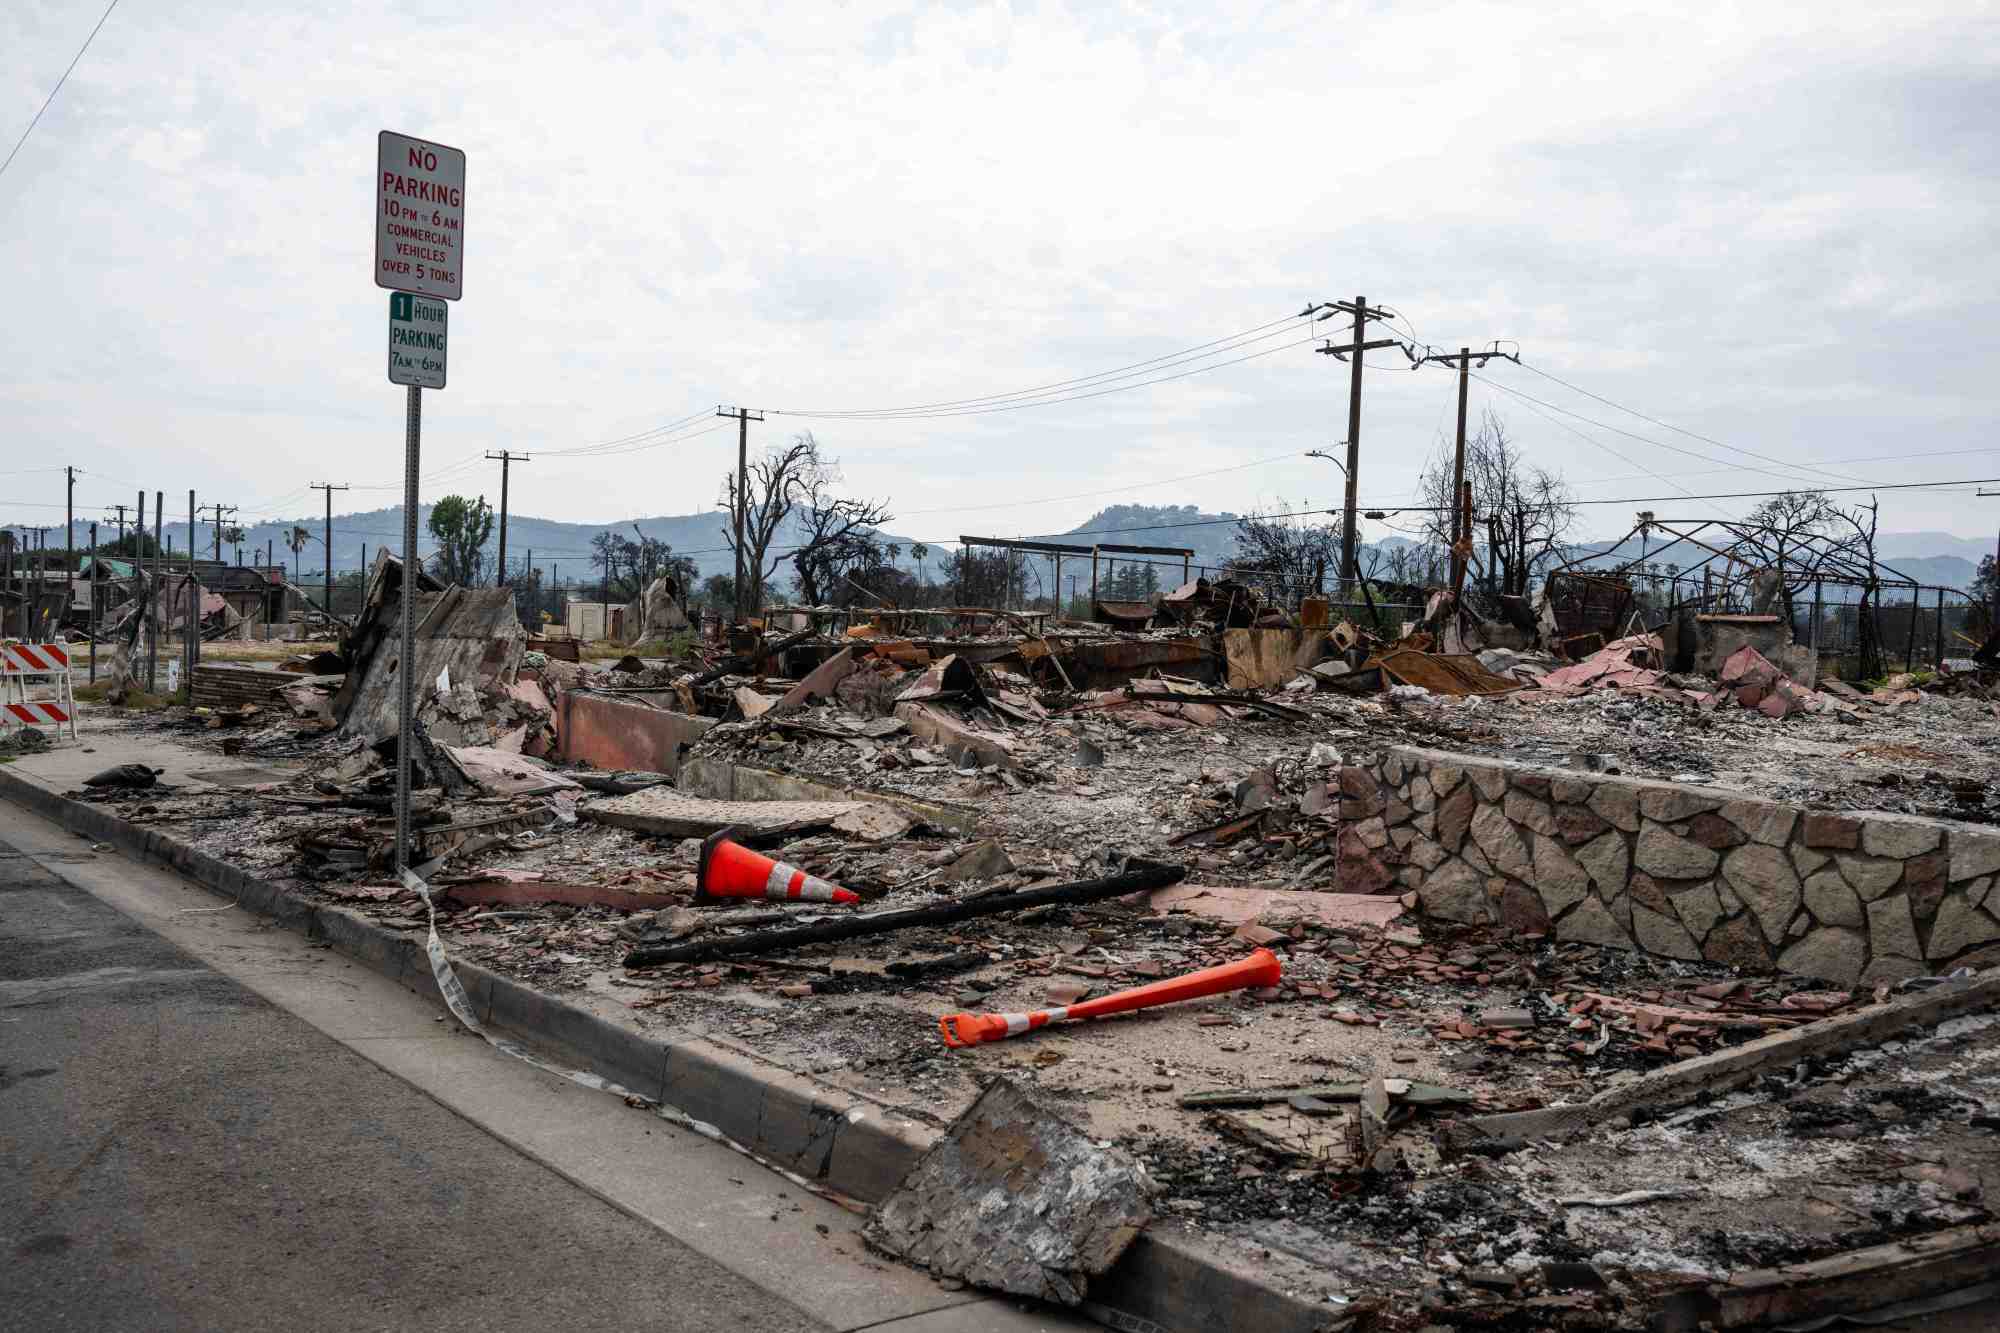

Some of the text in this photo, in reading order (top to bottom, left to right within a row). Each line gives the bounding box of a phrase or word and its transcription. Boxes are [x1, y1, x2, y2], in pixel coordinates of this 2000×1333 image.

[408, 147, 437, 171] NO
[383, 172, 460, 207] PARKING
[387, 223, 454, 248] COMMERCIAL
[396, 242, 446, 263] VEHICLES
[383, 259, 456, 284] OVER 5 TONS
[399, 297, 445, 323] 1 HOUR
[393, 327, 444, 350] PARKING
